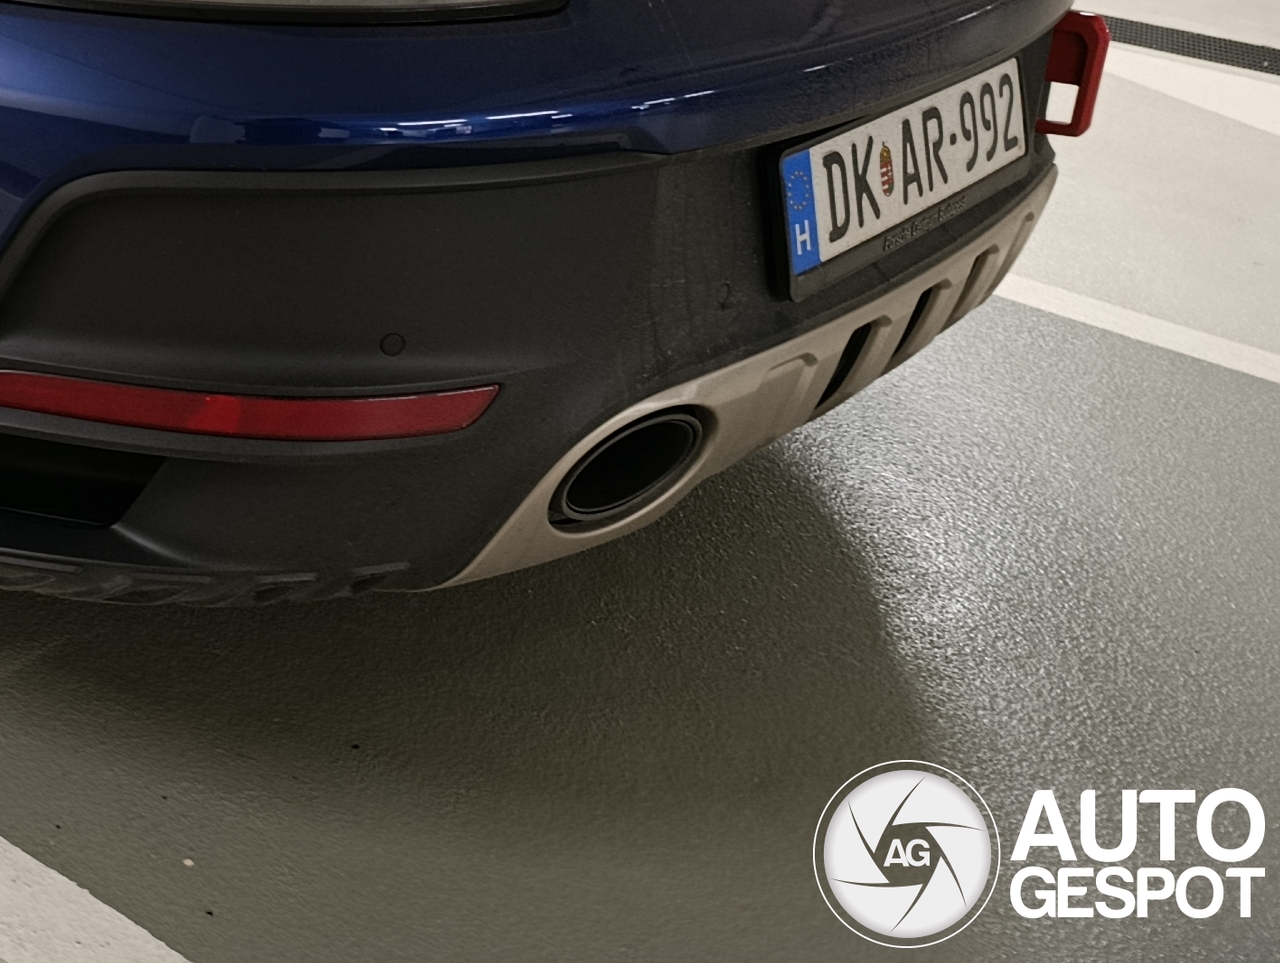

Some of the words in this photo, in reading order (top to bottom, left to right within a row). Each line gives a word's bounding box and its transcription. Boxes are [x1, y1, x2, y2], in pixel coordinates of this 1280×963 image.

[822, 135, 881, 244] DK
[901, 73, 1019, 205] AR-992
[795, 219, 812, 255] H
